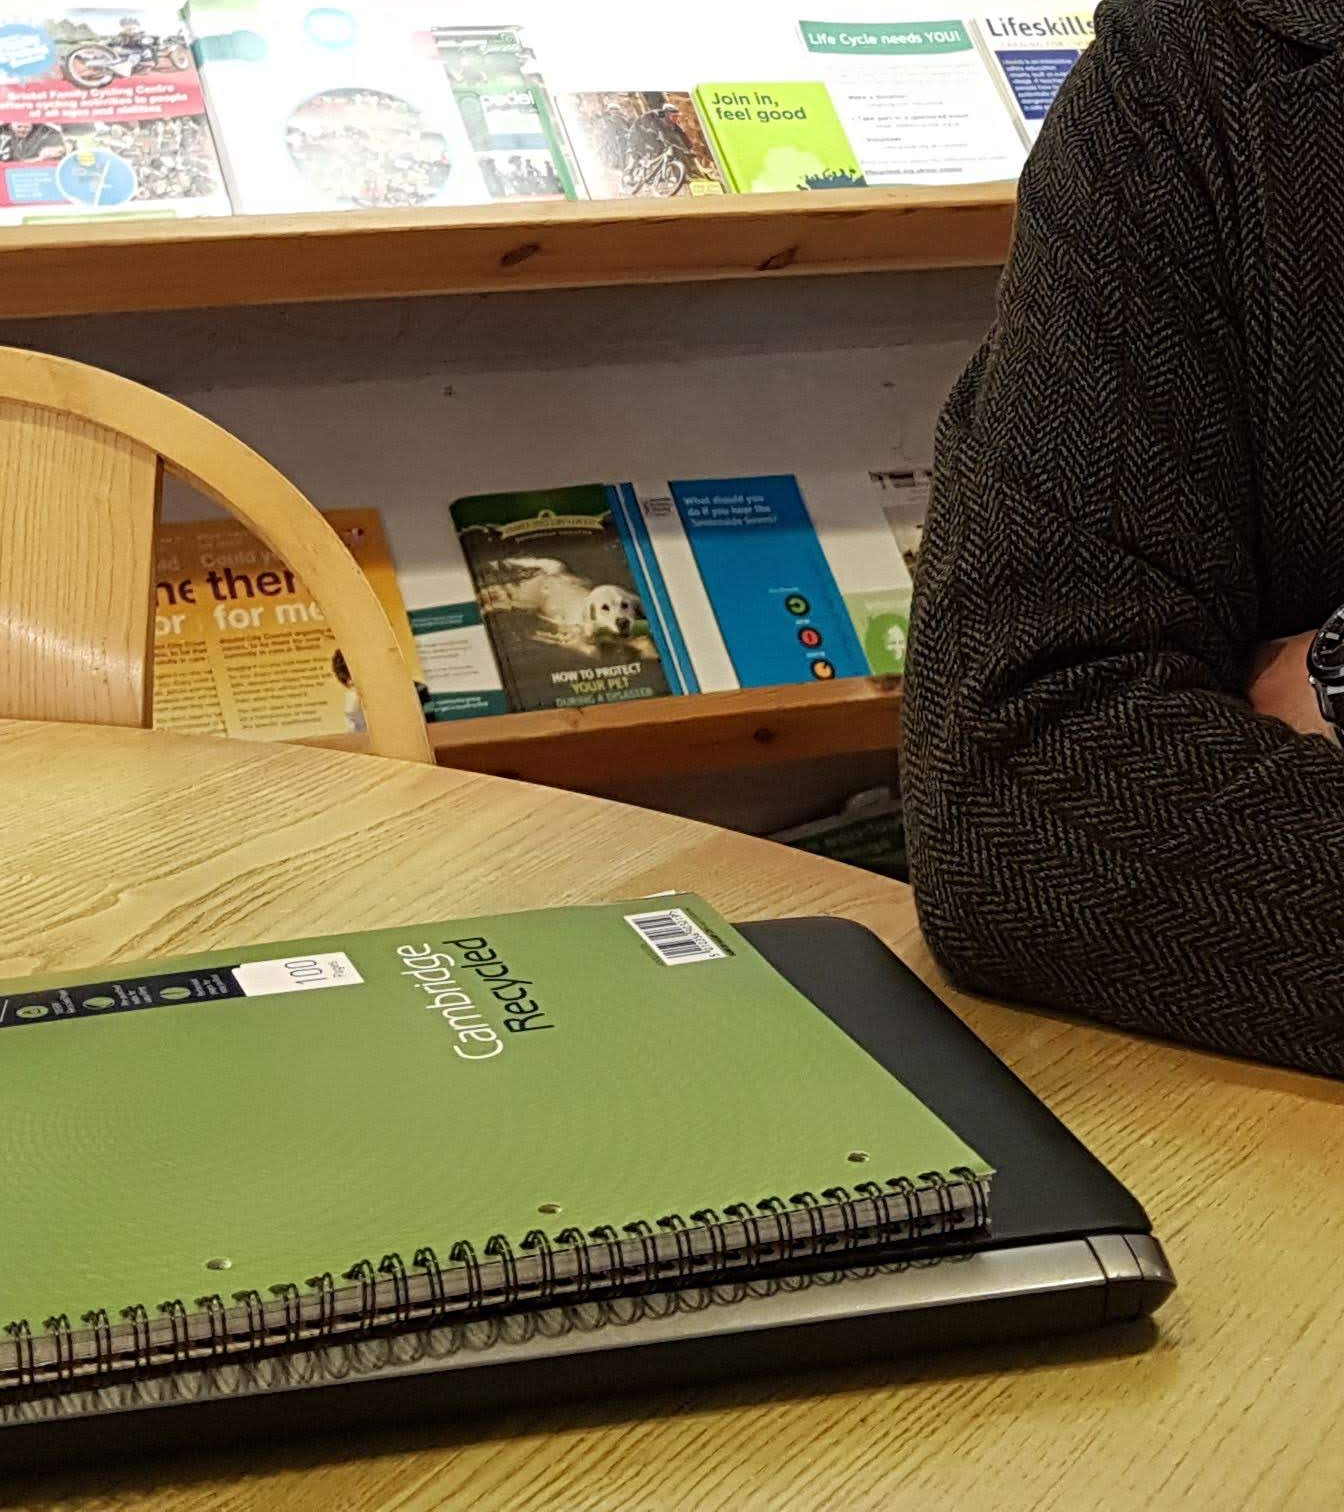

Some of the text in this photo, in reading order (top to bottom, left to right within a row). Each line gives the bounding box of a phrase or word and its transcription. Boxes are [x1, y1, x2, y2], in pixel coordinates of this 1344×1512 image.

[985, 15, 1096, 37] Lifeskills
[807, 30, 961, 47] Life Cycle needs YOU!
[8, 91, 47, 102] Bristol
[49, 89, 88, 100] Family
[89, 87, 134, 99] Cycling
[711, 91, 779, 109] Join in,
[715, 106, 807, 123] feel good
[206, 567, 296, 601] ther
[155, 599, 325, 636] or for me
[551, 662, 641, 684] HOW TO PROTECT
[570, 676, 629, 694] YOUR PET
[284, 959, 328, 985] 100
[442, 936, 556, 1034] Recycled
[396, 943, 504, 1060] Cambridge
